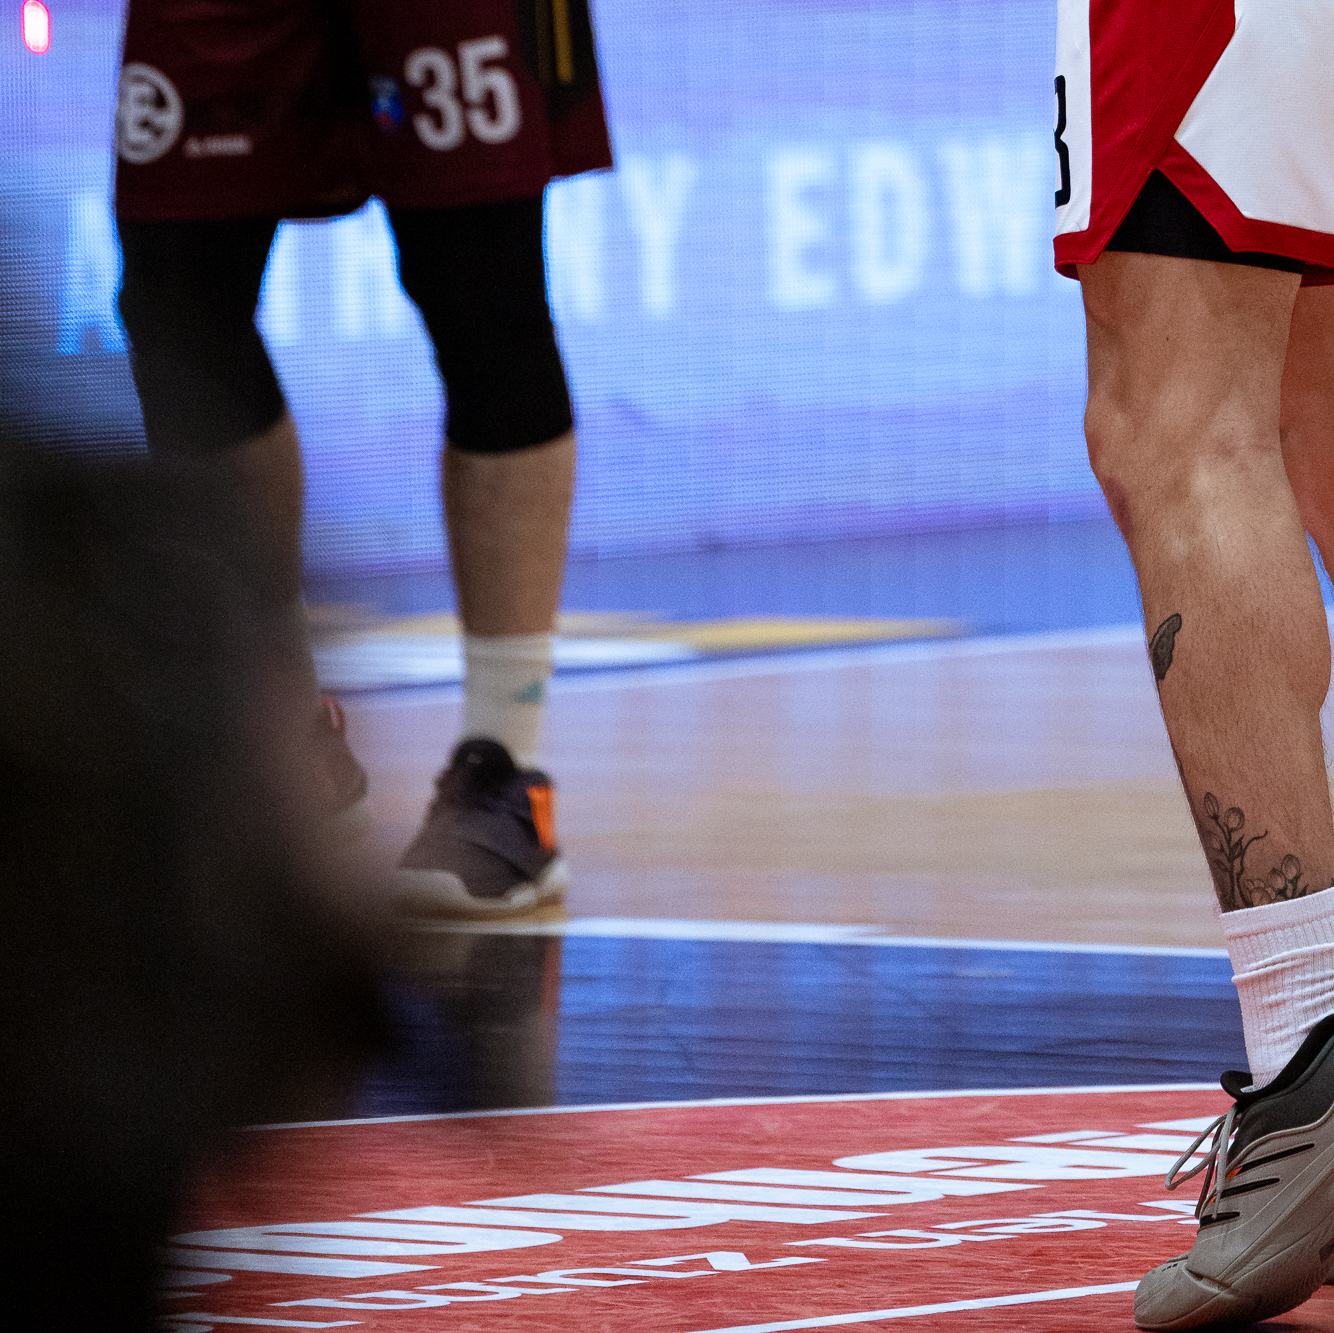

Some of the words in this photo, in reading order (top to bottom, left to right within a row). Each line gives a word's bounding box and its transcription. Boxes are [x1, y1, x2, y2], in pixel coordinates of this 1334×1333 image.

[403, 35, 523, 152] 35
[764, 131, 1055, 313] EDW
[783, 1199, 1201, 1250] ien
[267, 1251, 829, 1311] zum
